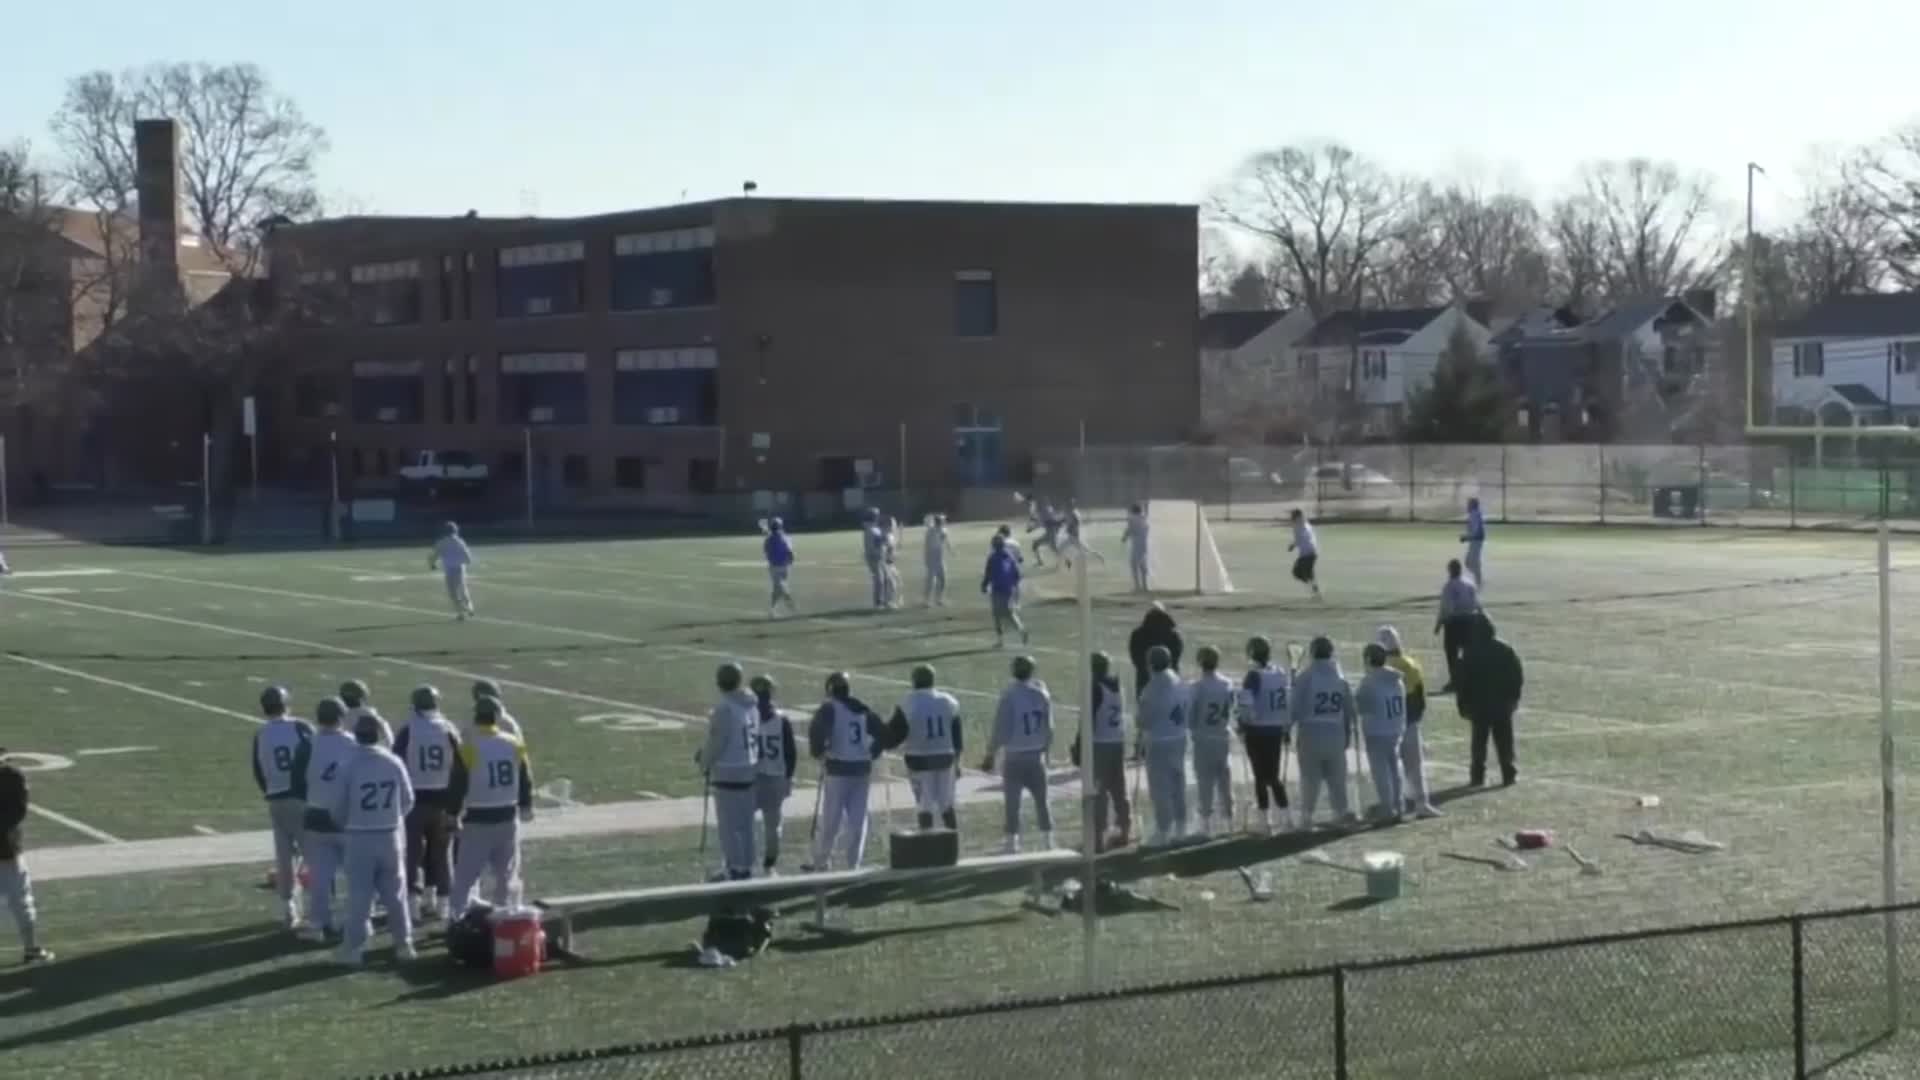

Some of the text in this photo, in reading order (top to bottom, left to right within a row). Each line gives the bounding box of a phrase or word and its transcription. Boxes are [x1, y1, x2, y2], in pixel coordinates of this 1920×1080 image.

[1314, 691, 1343, 715] 29
[1385, 695, 1403, 719] 10
[848, 721, 861, 744] 3
[927, 715, 945, 738] 11
[1023, 709, 1043, 736] 17
[273, 745, 292, 771] 8
[420, 744, 444, 772] 19
[487, 760, 514, 789] 18
[360, 780, 397, 810] 27
